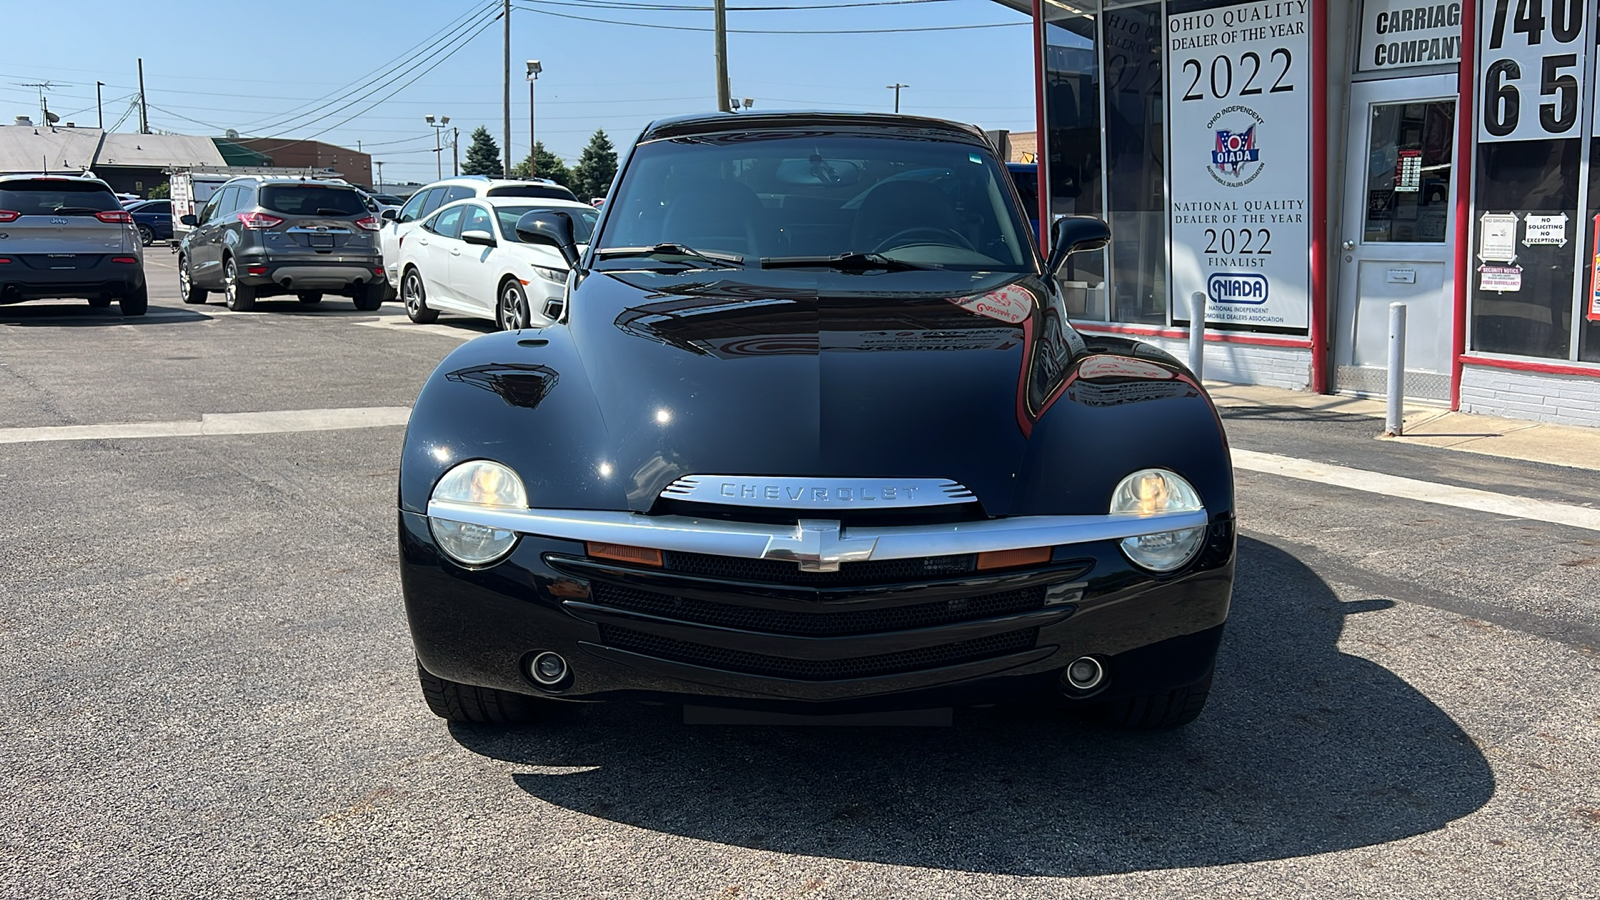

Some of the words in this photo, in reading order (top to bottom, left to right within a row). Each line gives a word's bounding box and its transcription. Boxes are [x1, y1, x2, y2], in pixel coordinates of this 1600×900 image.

[1170, 14, 1214, 33] OHIO
[1223, 0, 1307, 27] QUALITY
[1376, 3, 1462, 34] CARRIAG
[1172, 33, 1218, 51] DEALER
[1221, 31, 1237, 44] OF
[1240, 27, 1266, 41] THE
[1269, 22, 1305, 38] YEAR
[1182, 47, 1293, 101] 2022
[1207, 112, 1222, 129] OHIO
[1221, 105, 1265, 125] INDEPENDENT
[1217, 150, 1251, 163] OIADA
[1174, 201, 1238, 212] NATIONAL
[1244, 200, 1304, 212] QUALITY
[1175, 215, 1218, 224] DEALER
[1222, 214, 1237, 224] OF
[1242, 214, 1265, 223] THE
[1271, 213, 1302, 223] YEAR
[1204, 228, 1272, 254] 2022
[1208, 257, 1265, 267] FINALIST
[1212, 279, 1263, 298] NIADA
[1208, 305, 1233, 313] NATIONAL
[1234, 306, 1269, 314] INDEPENDENT
[1226, 313, 1248, 321] DEALERS
[1248, 315, 1284, 323] ASSOCIATION
[720, 482, 919, 501] CHEVROLET
